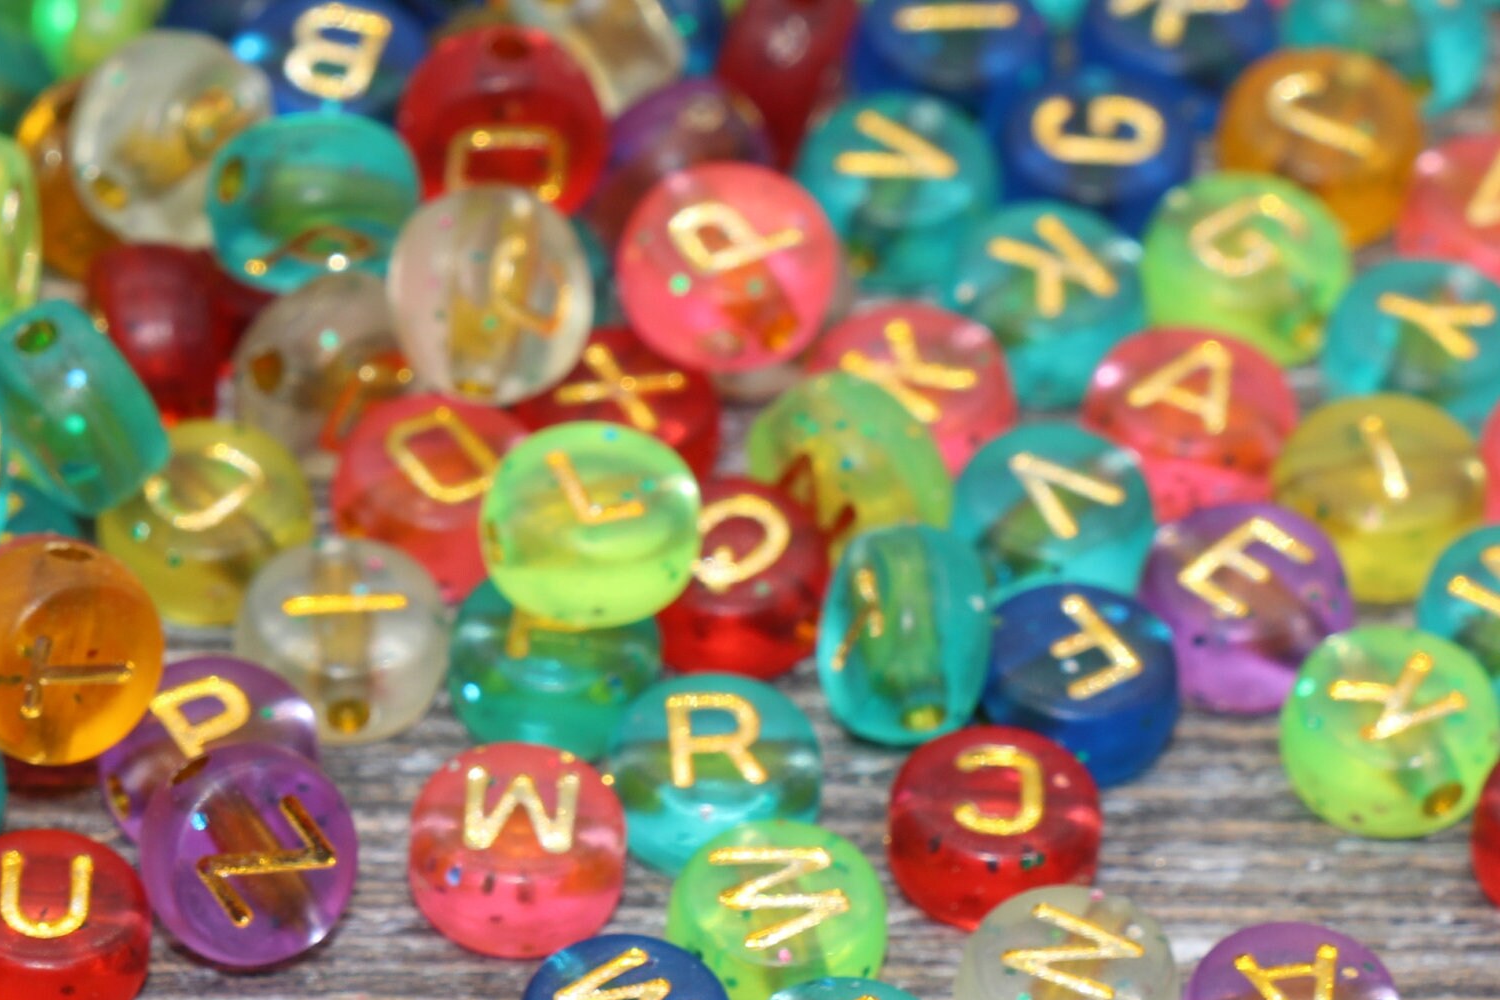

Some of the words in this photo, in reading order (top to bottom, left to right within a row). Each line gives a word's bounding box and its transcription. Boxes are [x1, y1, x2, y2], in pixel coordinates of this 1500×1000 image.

[284, 3, 392, 99] B
[834, 109, 959, 179] V
[1032, 95, 1165, 165] G
[667, 202, 803, 274] P
[1189, 192, 1312, 278] G
[555, 344, 687, 433] X
[839, 318, 978, 423] K
[1128, 339, 1233, 435] A
[543, 449, 646, 524] L
[1011, 452, 1126, 540] V
[1177, 518, 1315, 617] E
[1051, 593, 1144, 701] F
[665, 692, 769, 788] R
[1329, 651, 1468, 741] K
[954, 744, 1044, 836] C
[0, 849, 95, 939] U
